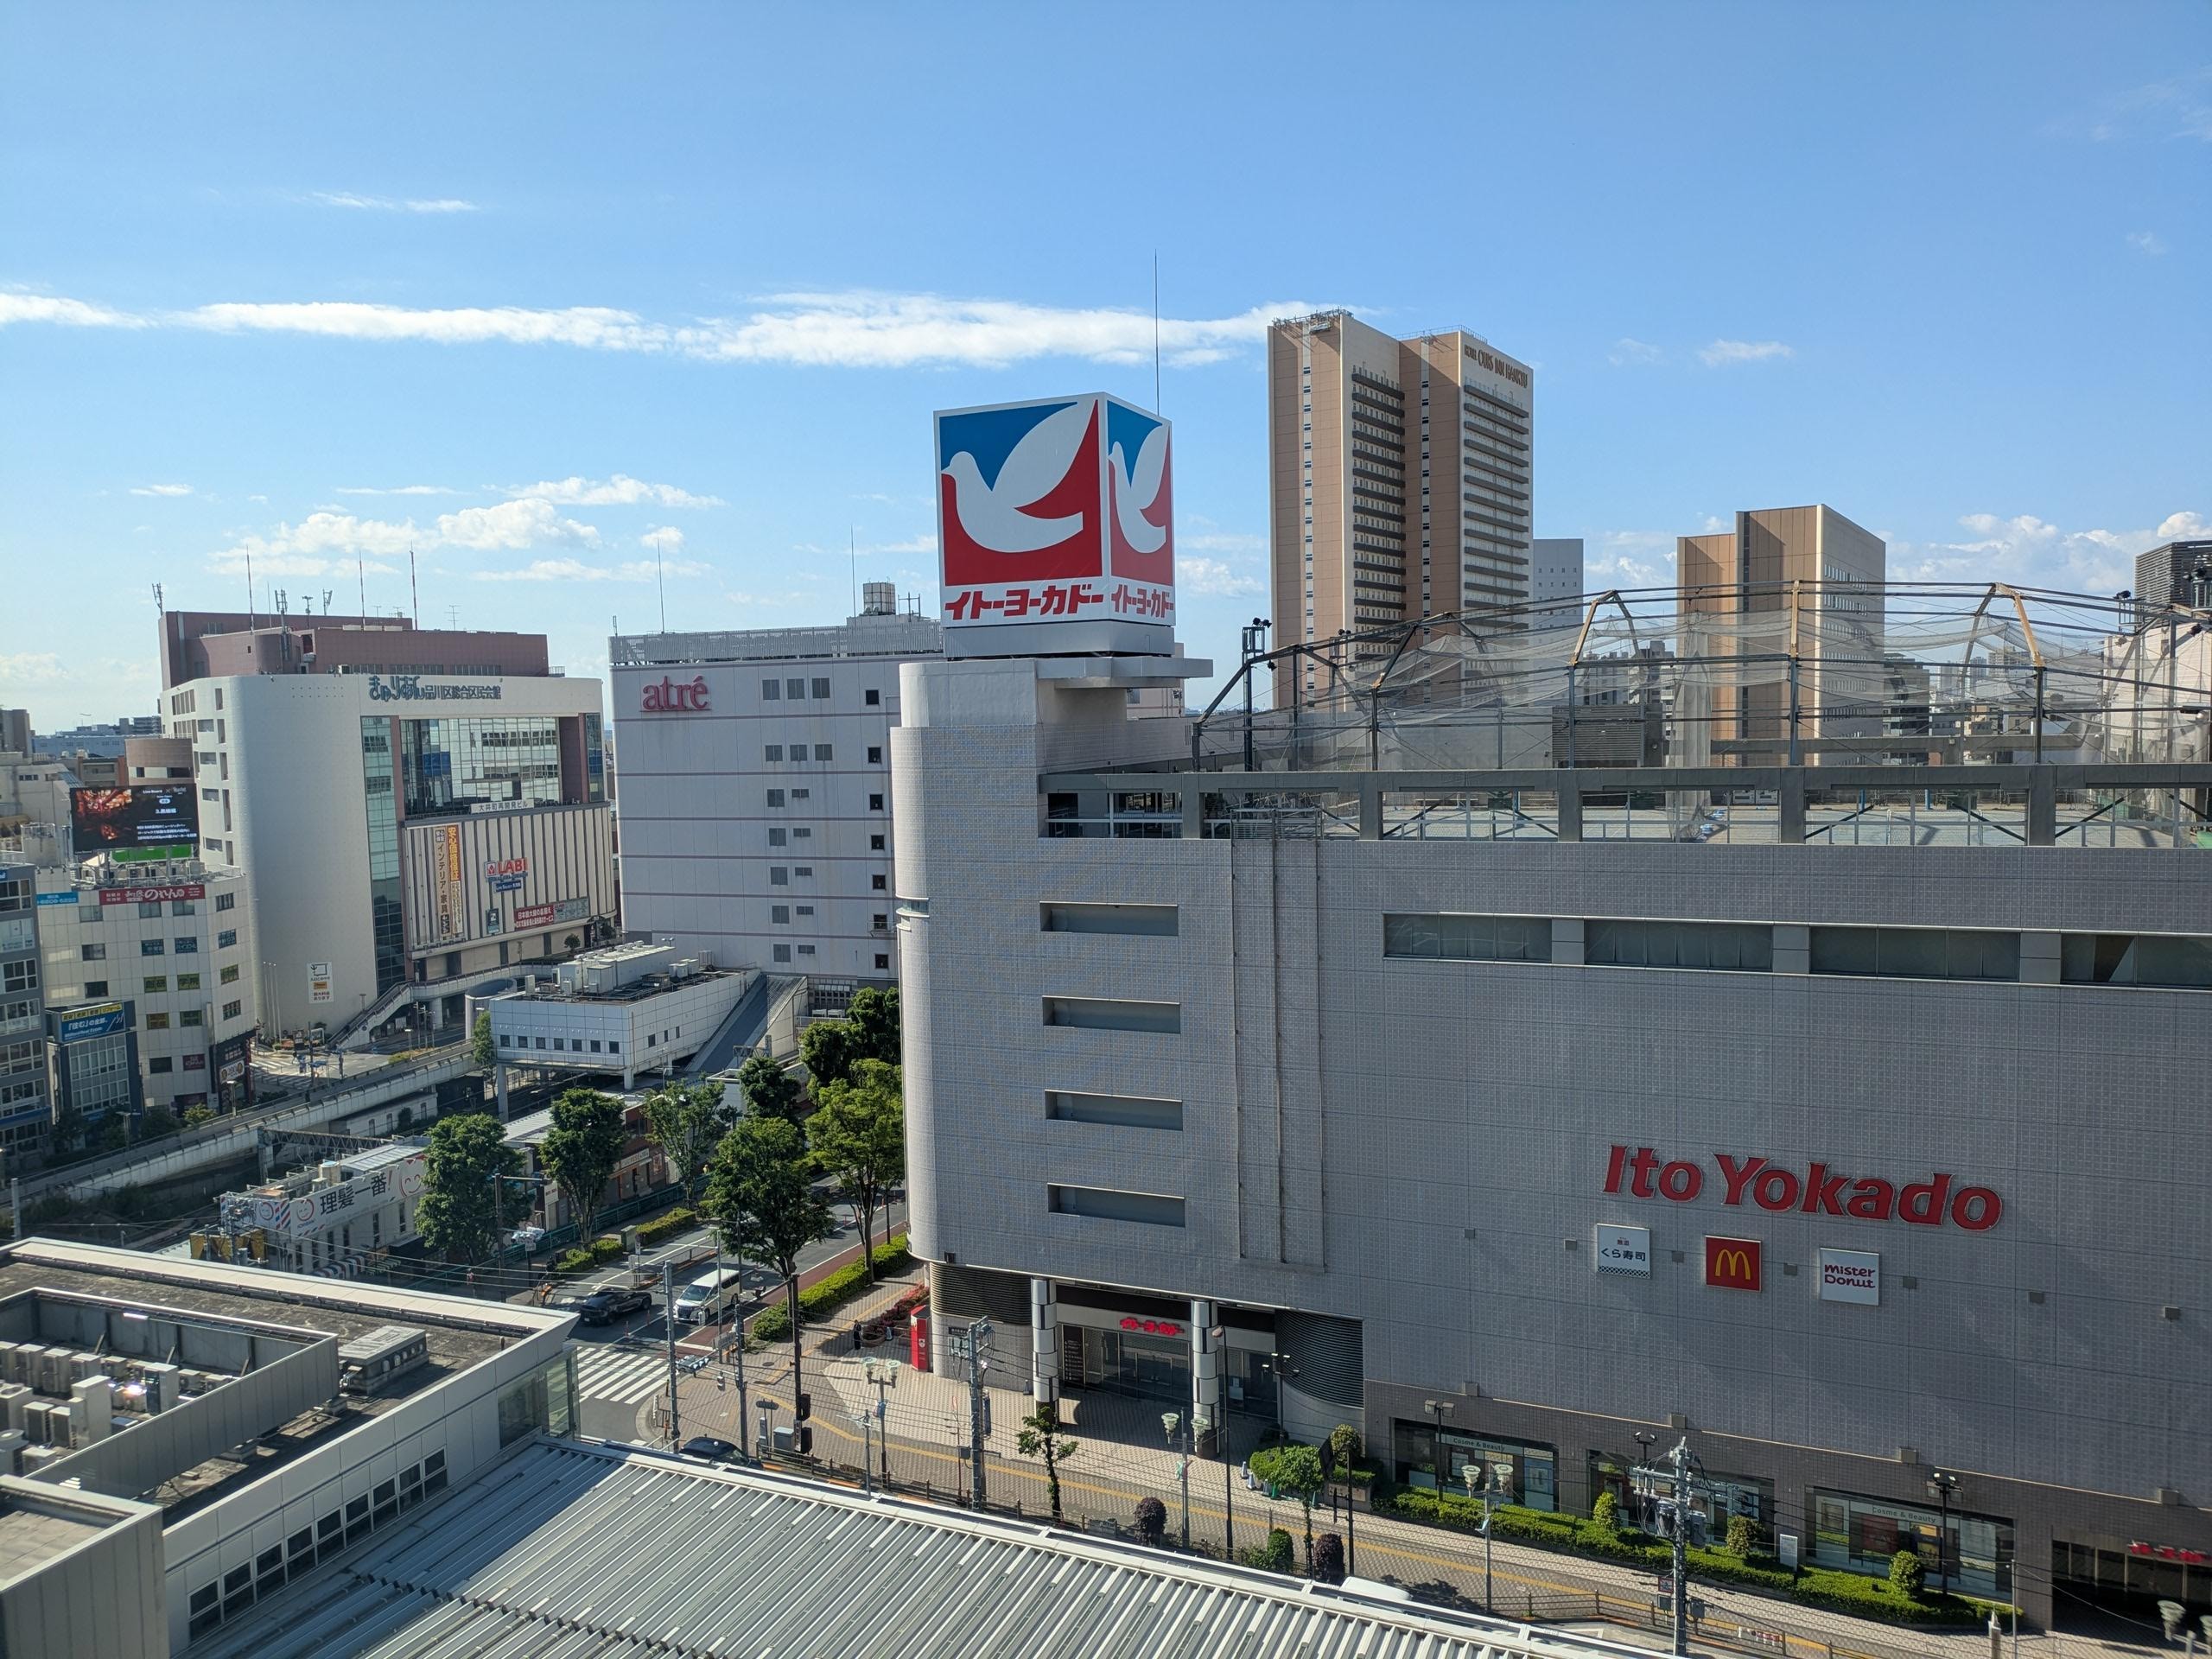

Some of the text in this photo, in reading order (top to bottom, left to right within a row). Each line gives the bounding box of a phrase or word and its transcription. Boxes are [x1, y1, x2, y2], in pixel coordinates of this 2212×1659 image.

[1478, 349, 1493, 371] OURS
[1495, 357, 1504, 377] INN
[1505, 364, 1528, 389] HANKYU
[945, 583, 1104, 620] イトーヨーカドー
[1111, 583, 1174, 619] イトーヨーカドー
[642, 675, 709, 710] atré
[479, 800, 528, 812] 大井町再開発ビル
[498, 857, 528, 875] LABI
[1602, 1145, 2003, 1231] Ito Yokado
[1601, 1248, 1646, 1262] くら寿司
[1824, 1274, 1876, 1288] Donut
[1453, 1437, 1474, 1446] Cosme
[1483, 1442, 1505, 1452] Beauty
[1872, 1505, 1897, 1517] Cosme
[1909, 1513, 1936, 1523] Beauty
